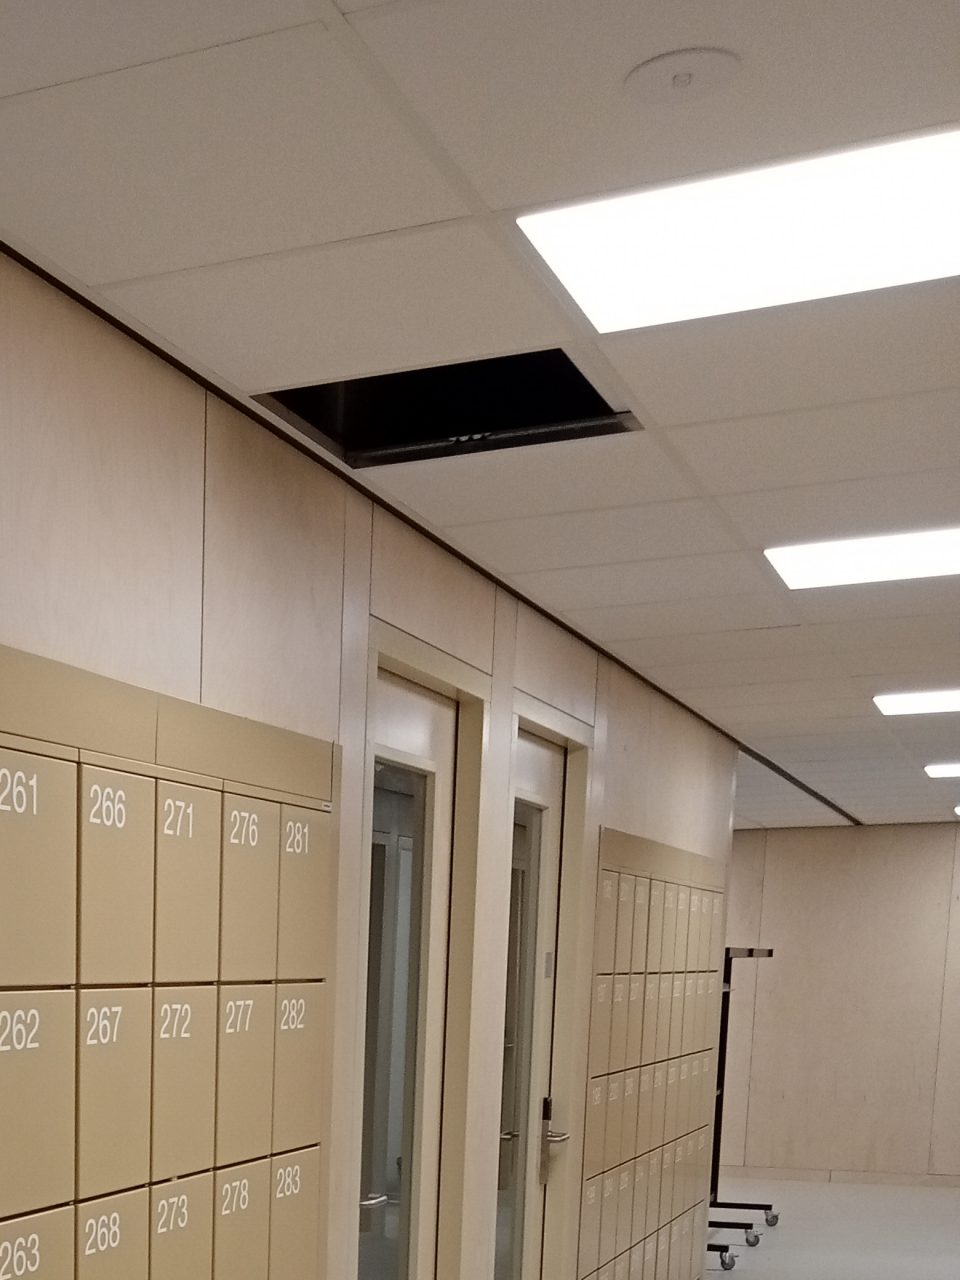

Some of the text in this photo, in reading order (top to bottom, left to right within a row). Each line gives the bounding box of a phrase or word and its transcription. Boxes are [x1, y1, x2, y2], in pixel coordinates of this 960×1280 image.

[89, 784, 126, 828] 266
[163, 798, 193, 838] 271
[230, 810, 258, 847] 276
[285, 821, 309, 853] 281
[86, 1006, 123, 1045] 267
[159, 1003, 191, 1039] 272
[225, 999, 254, 1033] 277
[280, 998, 305, 1030] 282
[221, 1178, 249, 1216] 278
[276, 1165, 301, 1198] 283
[157, 1194, 188, 1234] 273
[84, 1212, 120, 1256] 268
